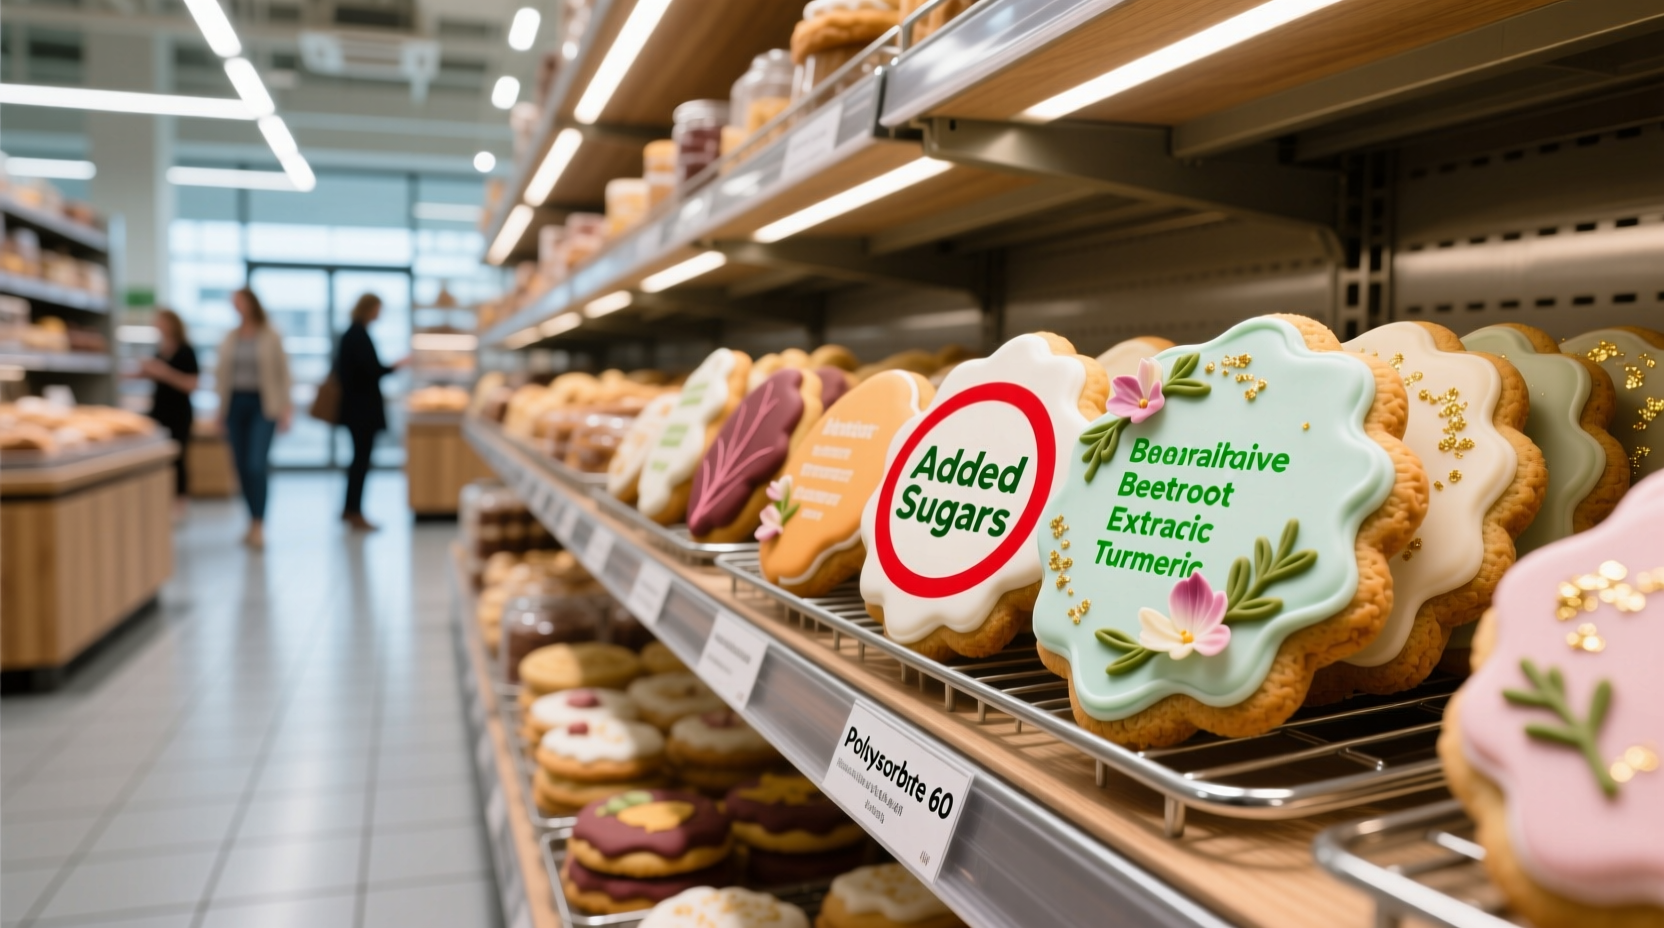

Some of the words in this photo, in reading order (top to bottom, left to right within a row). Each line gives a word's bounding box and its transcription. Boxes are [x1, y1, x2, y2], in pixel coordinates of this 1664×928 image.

[910, 445, 1029, 494] Added
[1117, 471, 1236, 508] Beetroot
[895, 484, 1011, 538] Sugars
[928, 786, 954, 820] 60
